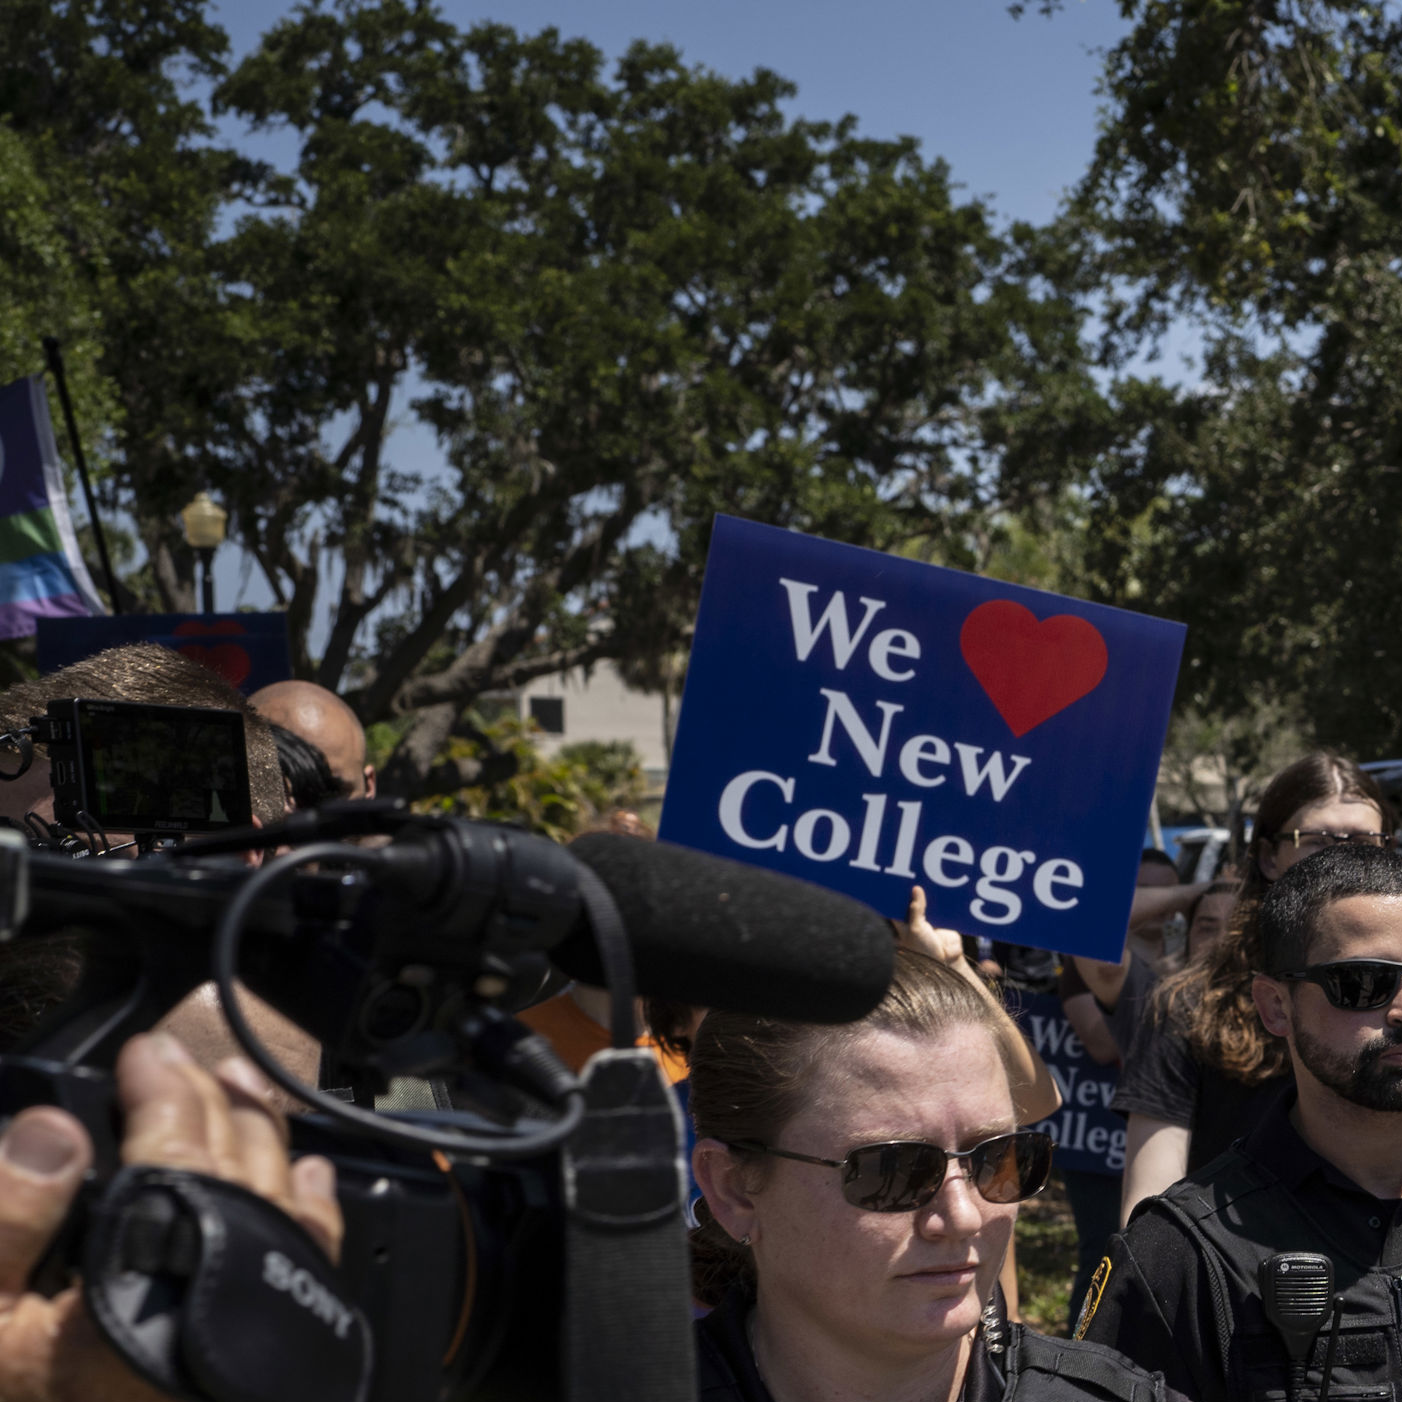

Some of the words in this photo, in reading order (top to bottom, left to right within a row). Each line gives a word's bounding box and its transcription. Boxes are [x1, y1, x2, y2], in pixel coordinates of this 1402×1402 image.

[779, 577, 921, 682] We
[808, 687, 1032, 802] New
[719, 770, 1084, 925] College
[1029, 1015, 1084, 1058] We
[263, 1250, 353, 1338] SONY
